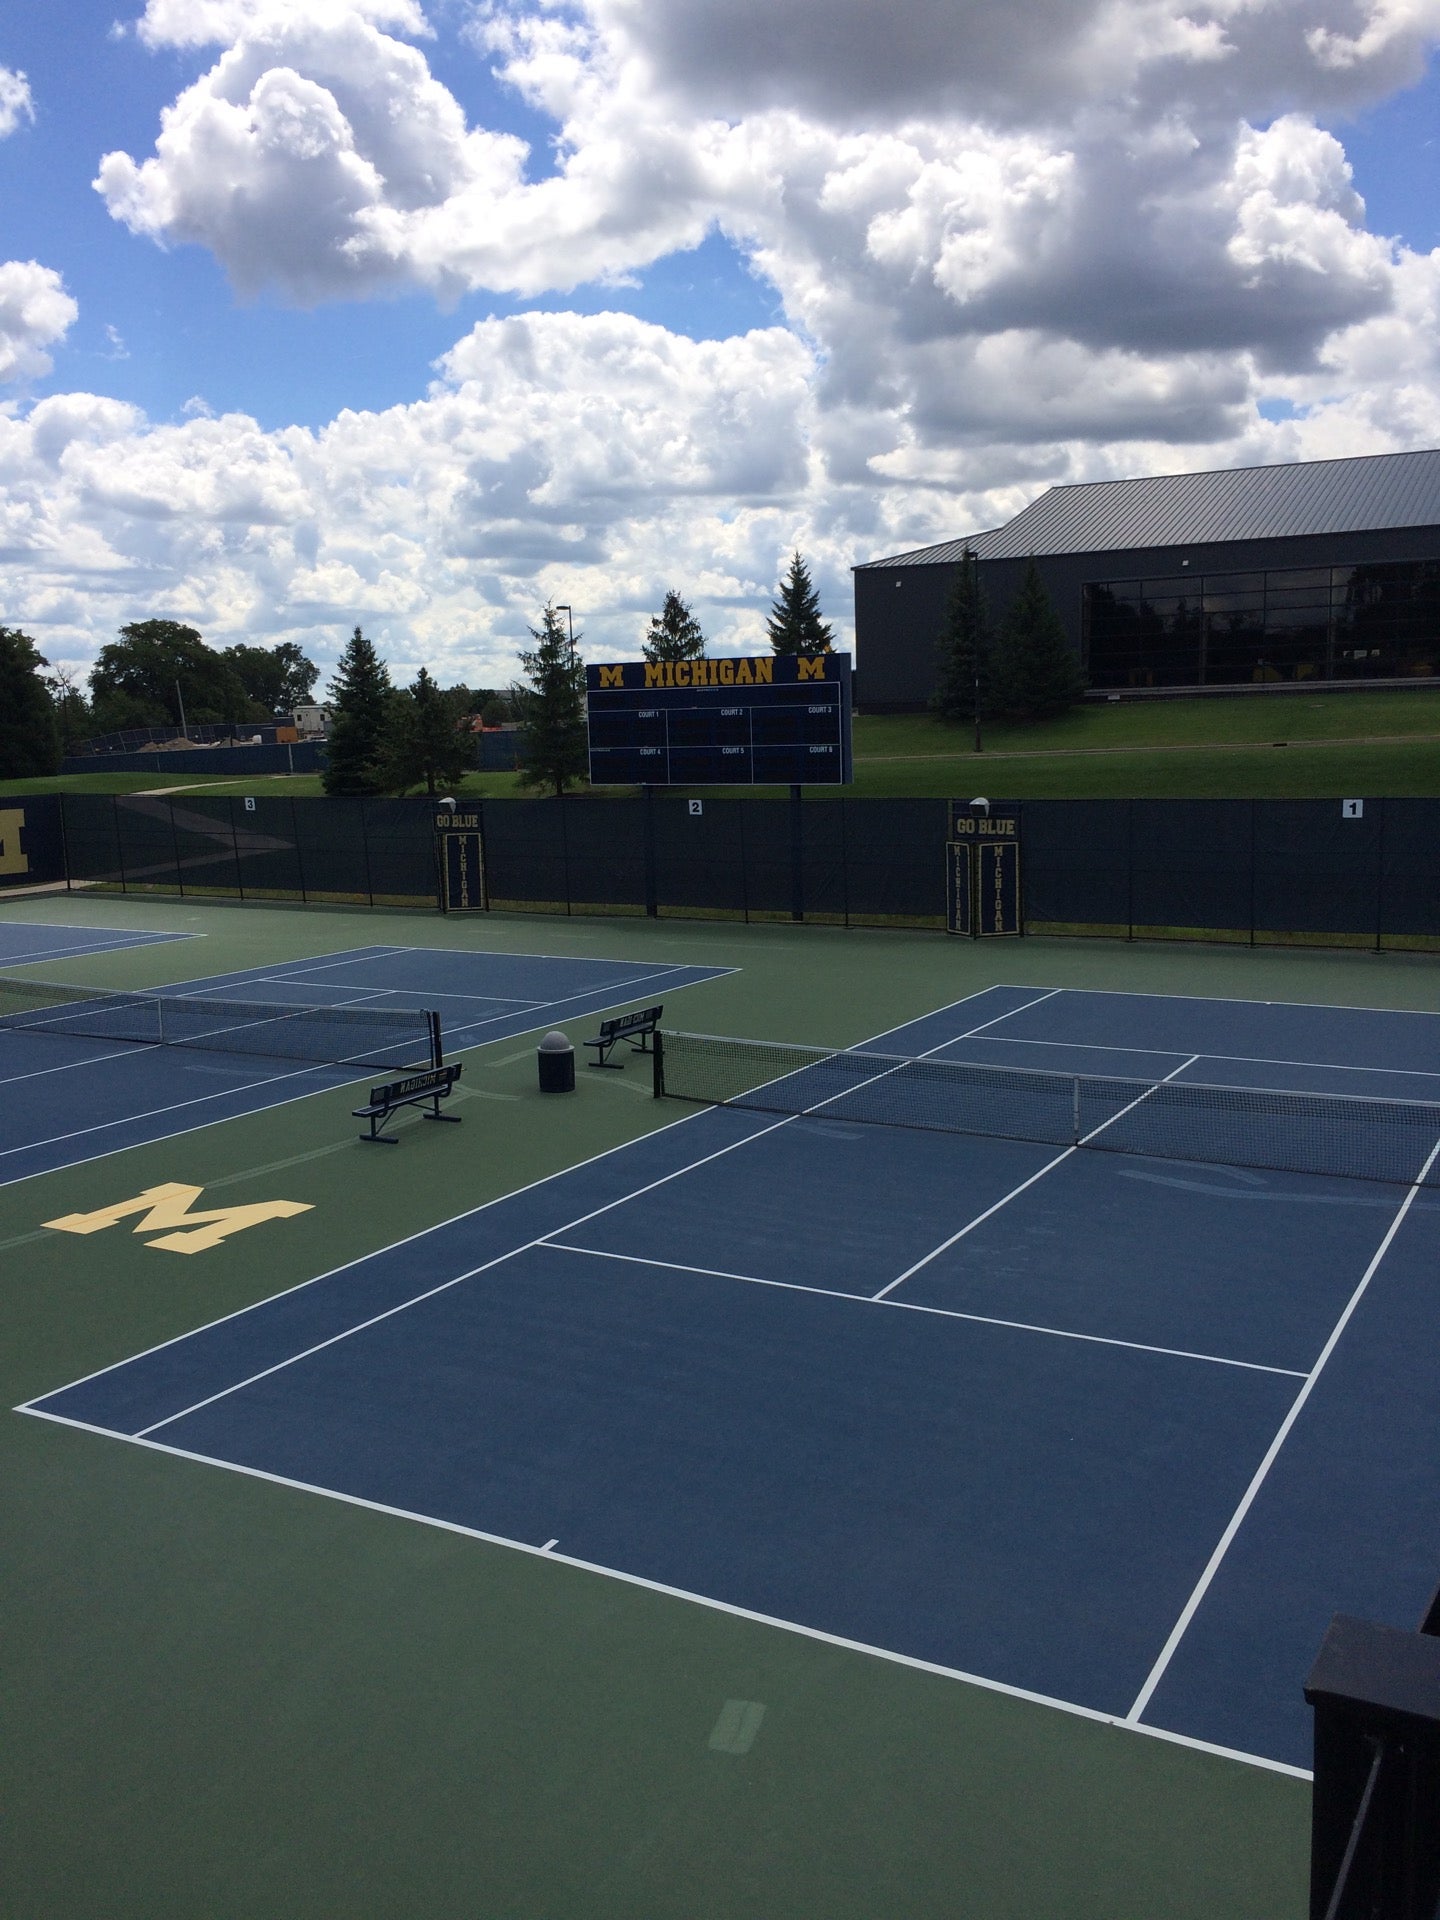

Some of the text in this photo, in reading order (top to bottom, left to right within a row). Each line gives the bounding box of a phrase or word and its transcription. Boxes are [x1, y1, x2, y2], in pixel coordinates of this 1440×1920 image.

[599, 656, 825, 688] M MICHIGAN M
[808, 706, 827, 714] COURT
[248, 799, 254, 808] 3
[692, 802, 700, 812] 2
[1349, 802, 1357, 815] 1
[437, 815, 478, 827] GO BLUE
[957, 818, 1015, 835] GO BLUE
[459, 836, 469, 907] MICHIGAN
[994, 846, 1003, 931] MICHIGAN
[40, 1182, 317, 1255] M
